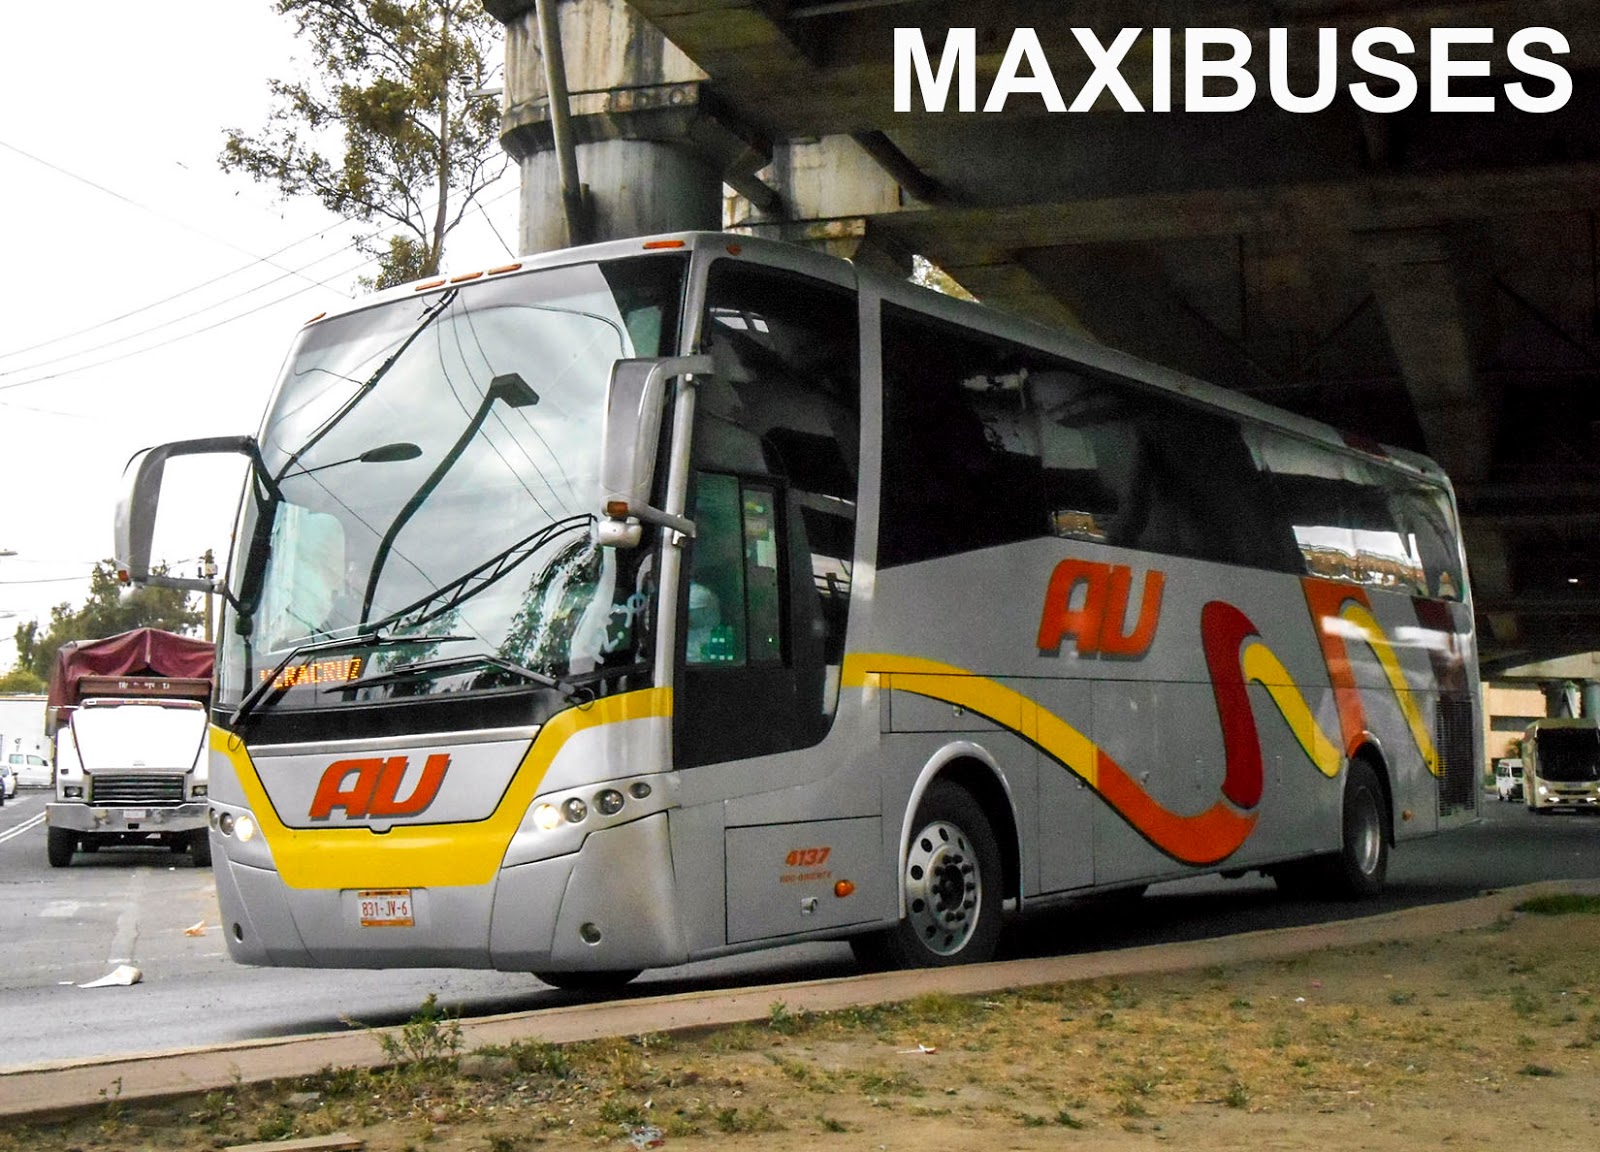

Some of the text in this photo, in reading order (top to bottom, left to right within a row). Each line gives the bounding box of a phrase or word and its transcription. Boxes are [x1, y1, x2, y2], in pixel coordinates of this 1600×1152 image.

[1036, 556, 1165, 658] AU
[308, 752, 451, 819] AU
[785, 847, 832, 867] 4137
